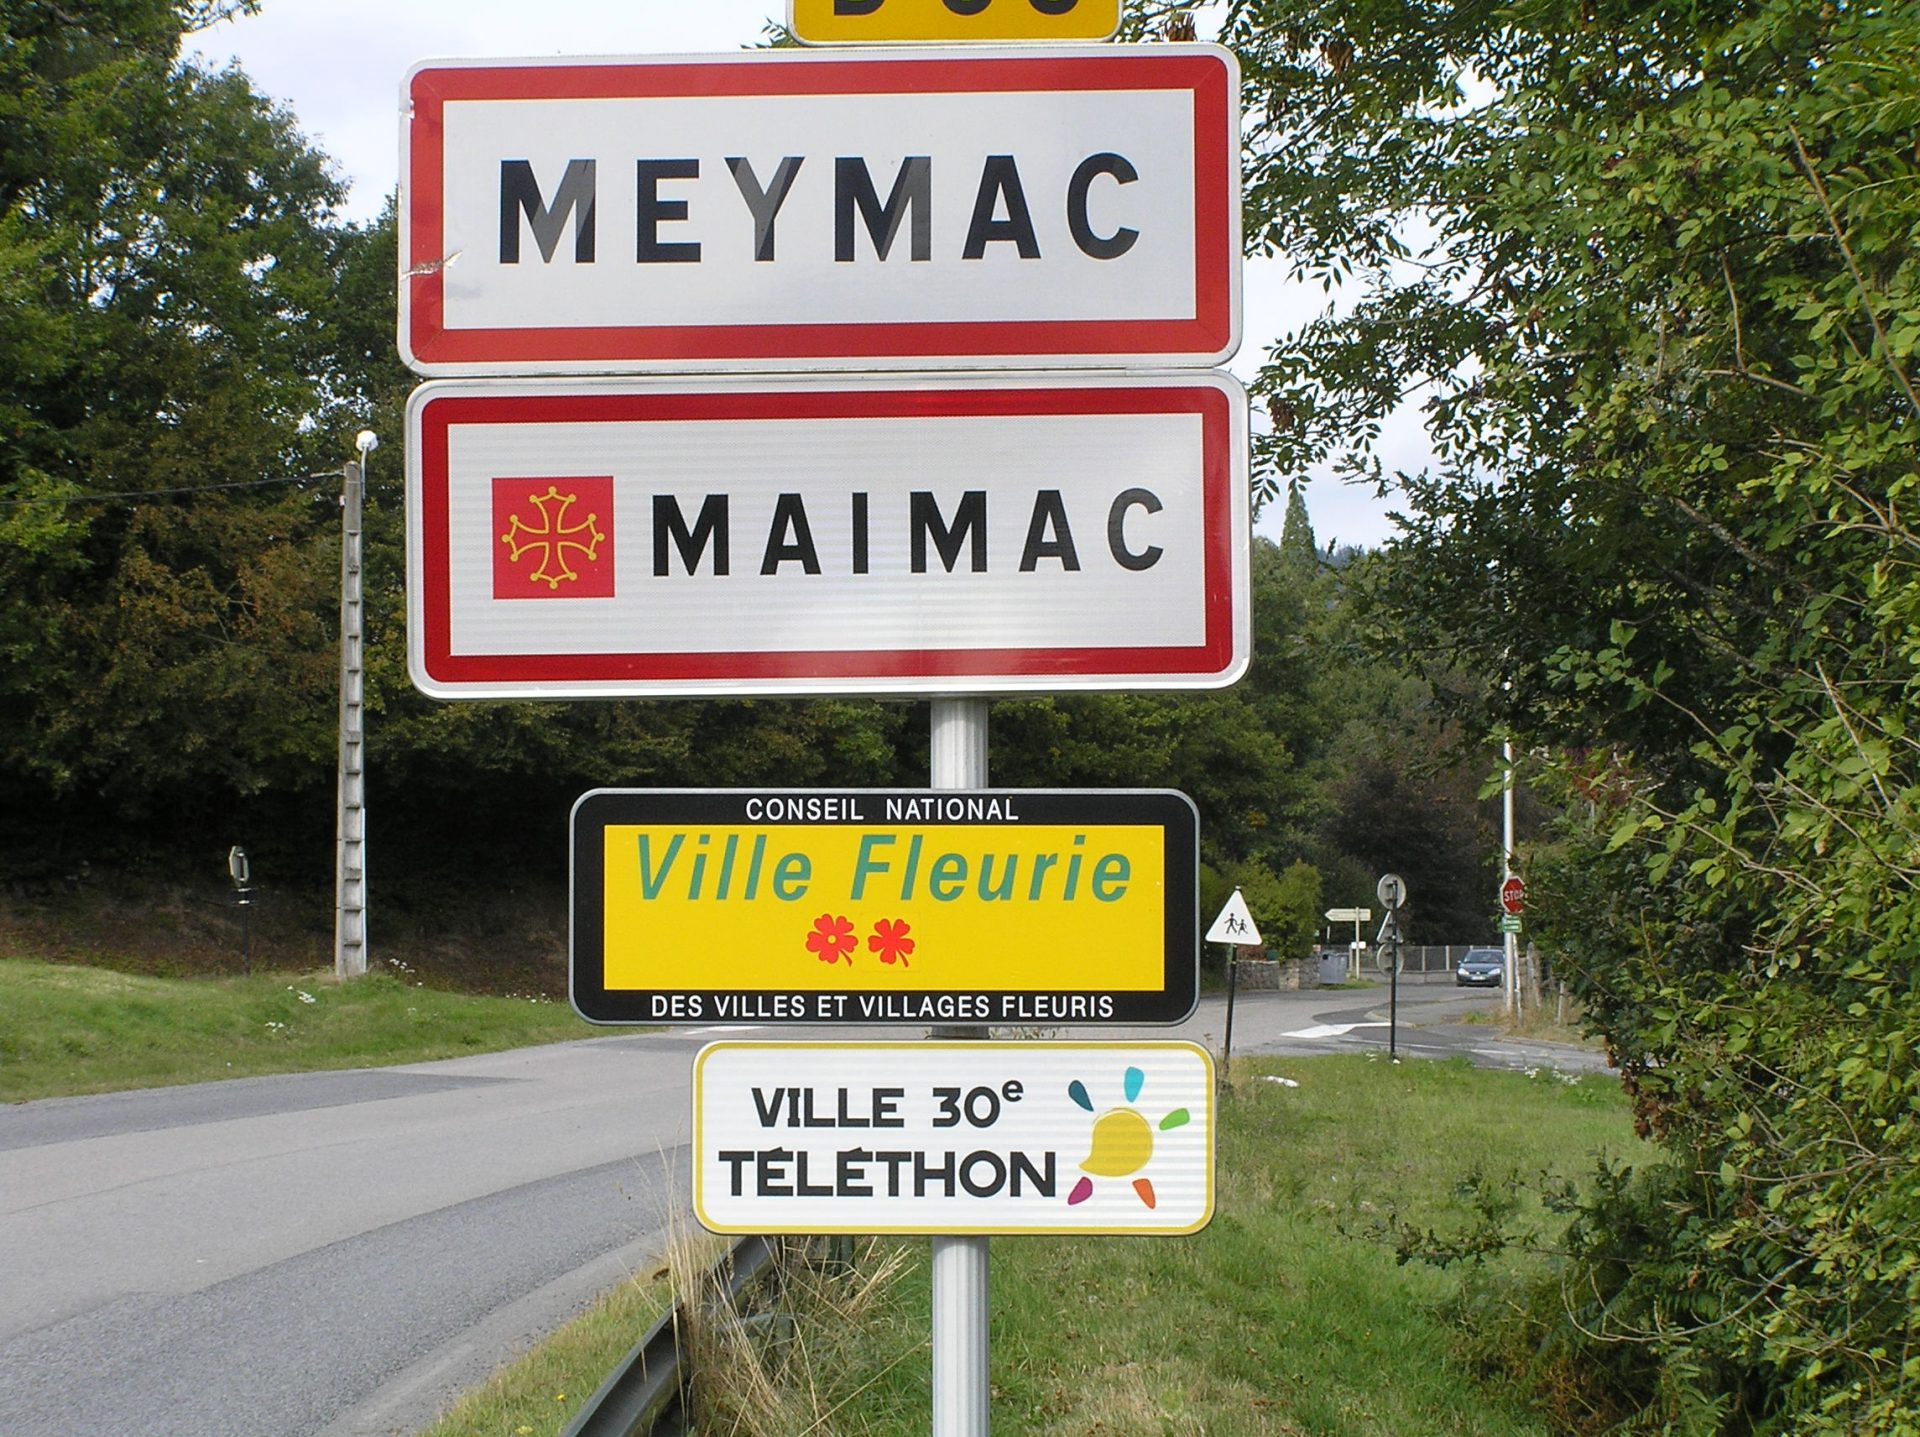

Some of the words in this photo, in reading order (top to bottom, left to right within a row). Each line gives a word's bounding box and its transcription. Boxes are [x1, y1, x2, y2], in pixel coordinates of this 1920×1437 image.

[499, 152, 1140, 265] MEYMAC
[652, 487, 1164, 577] MAIMAC
[745, 797, 865, 821] CONSEIL
[886, 797, 1019, 821] NATIONAL
[638, 834, 811, 901] Ville
[851, 834, 1131, 902] Fleurie
[651, 995, 703, 1018] DES
[713, 995, 806, 1018] VILLES
[817, 995, 848, 1018] ET
[858, 995, 990, 1018] VILLAGES
[1002, 995, 1114, 1018] FLEURIS
[751, 1087, 905, 1128] VILLE
[932, 1080, 1024, 1129] 30e
[718, 1146, 1056, 1198] TÉLÉTHON
